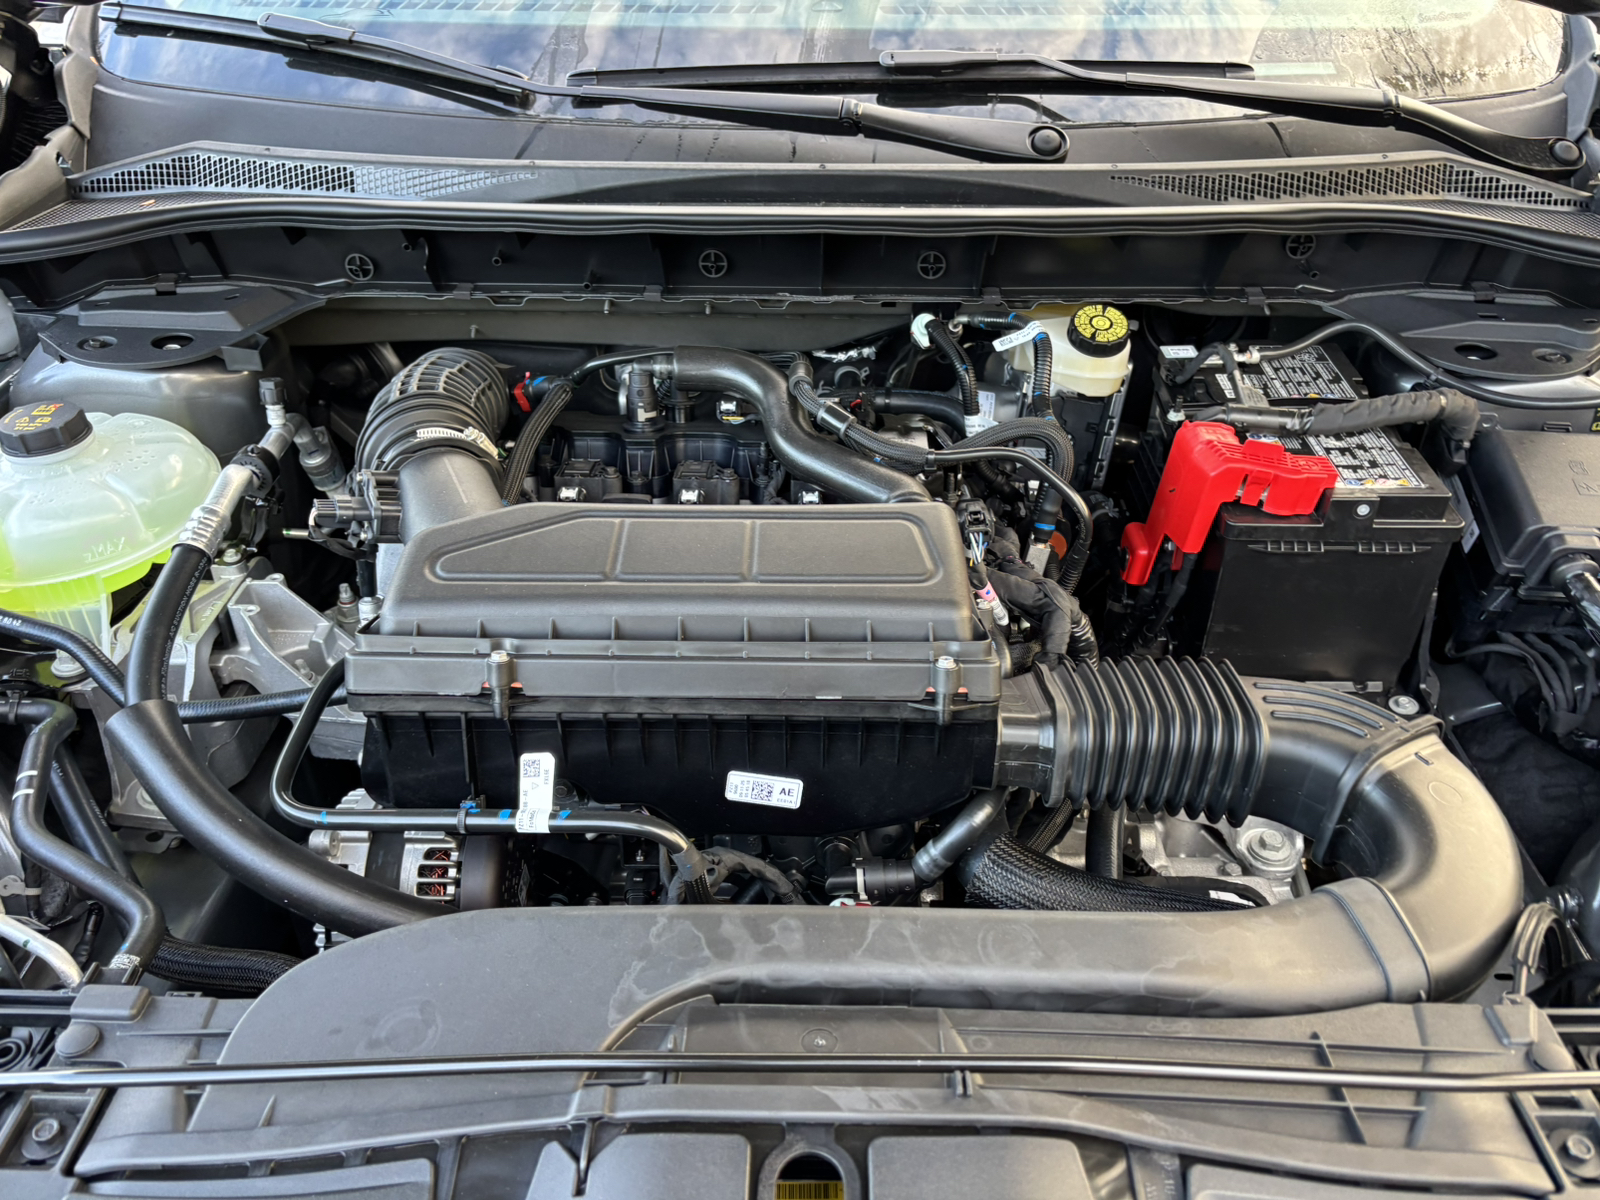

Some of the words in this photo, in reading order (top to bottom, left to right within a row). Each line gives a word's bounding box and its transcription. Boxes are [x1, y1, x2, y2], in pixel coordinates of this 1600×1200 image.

[173, 596, 189, 627] SUCTION
[185, 577, 197, 597] HOSE
[779, 787, 795, 797] AE
